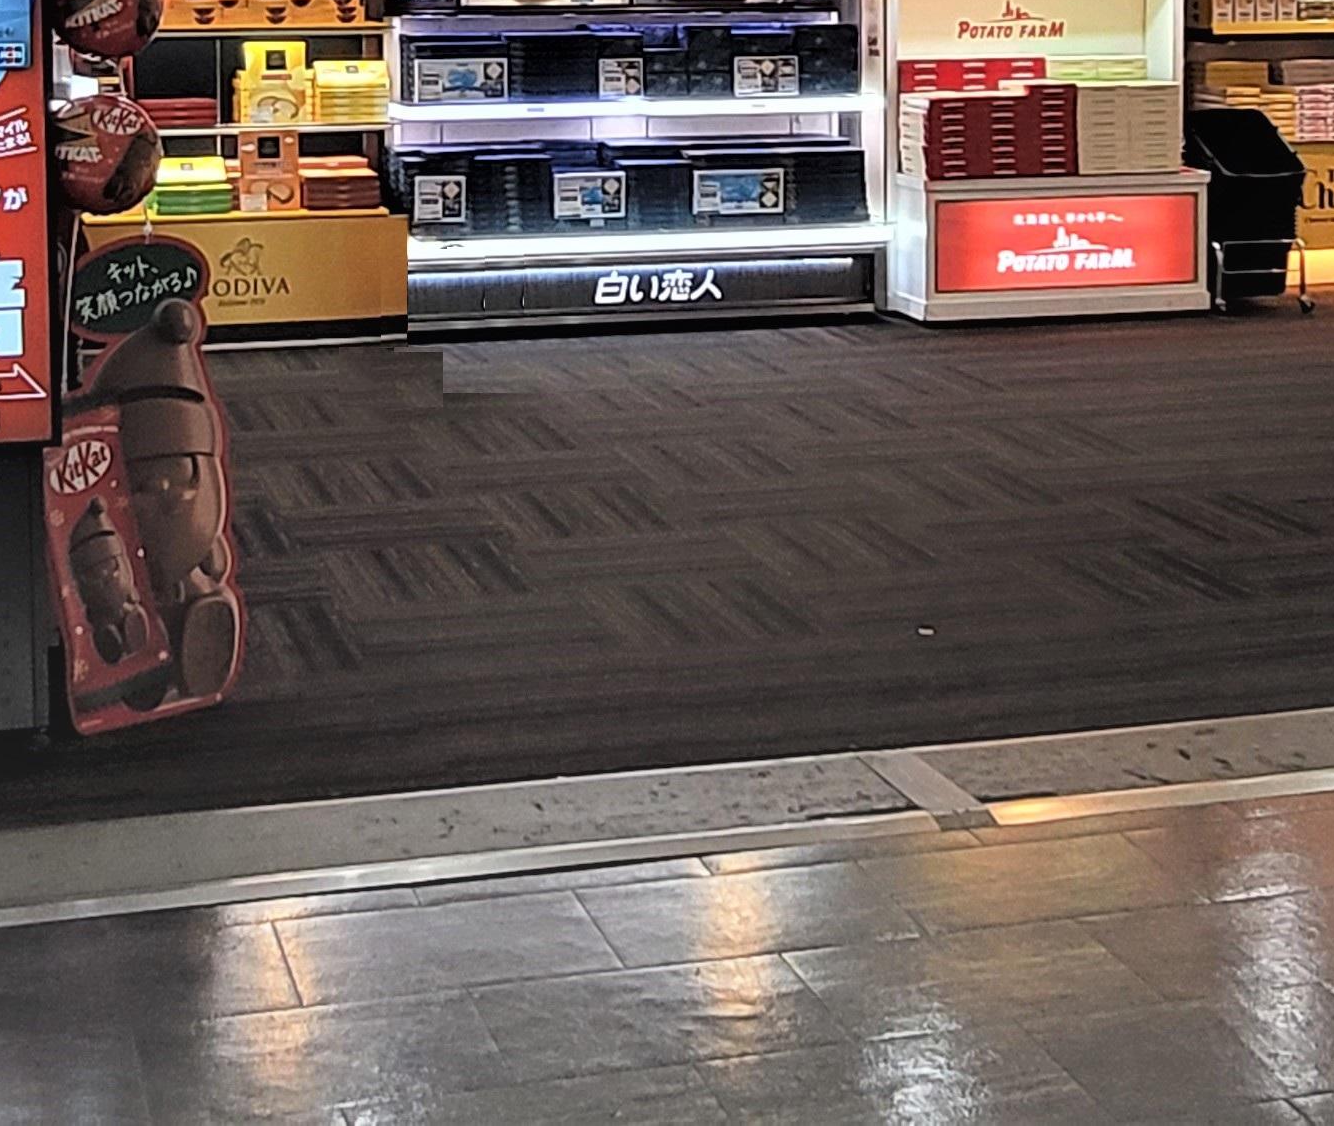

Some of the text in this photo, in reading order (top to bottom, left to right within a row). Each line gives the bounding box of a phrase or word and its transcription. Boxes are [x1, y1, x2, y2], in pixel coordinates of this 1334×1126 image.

[205, 276, 291, 297] ODIVA
[594, 269, 723, 305] 白い恋人
[54, 443, 109, 492] KitKat
